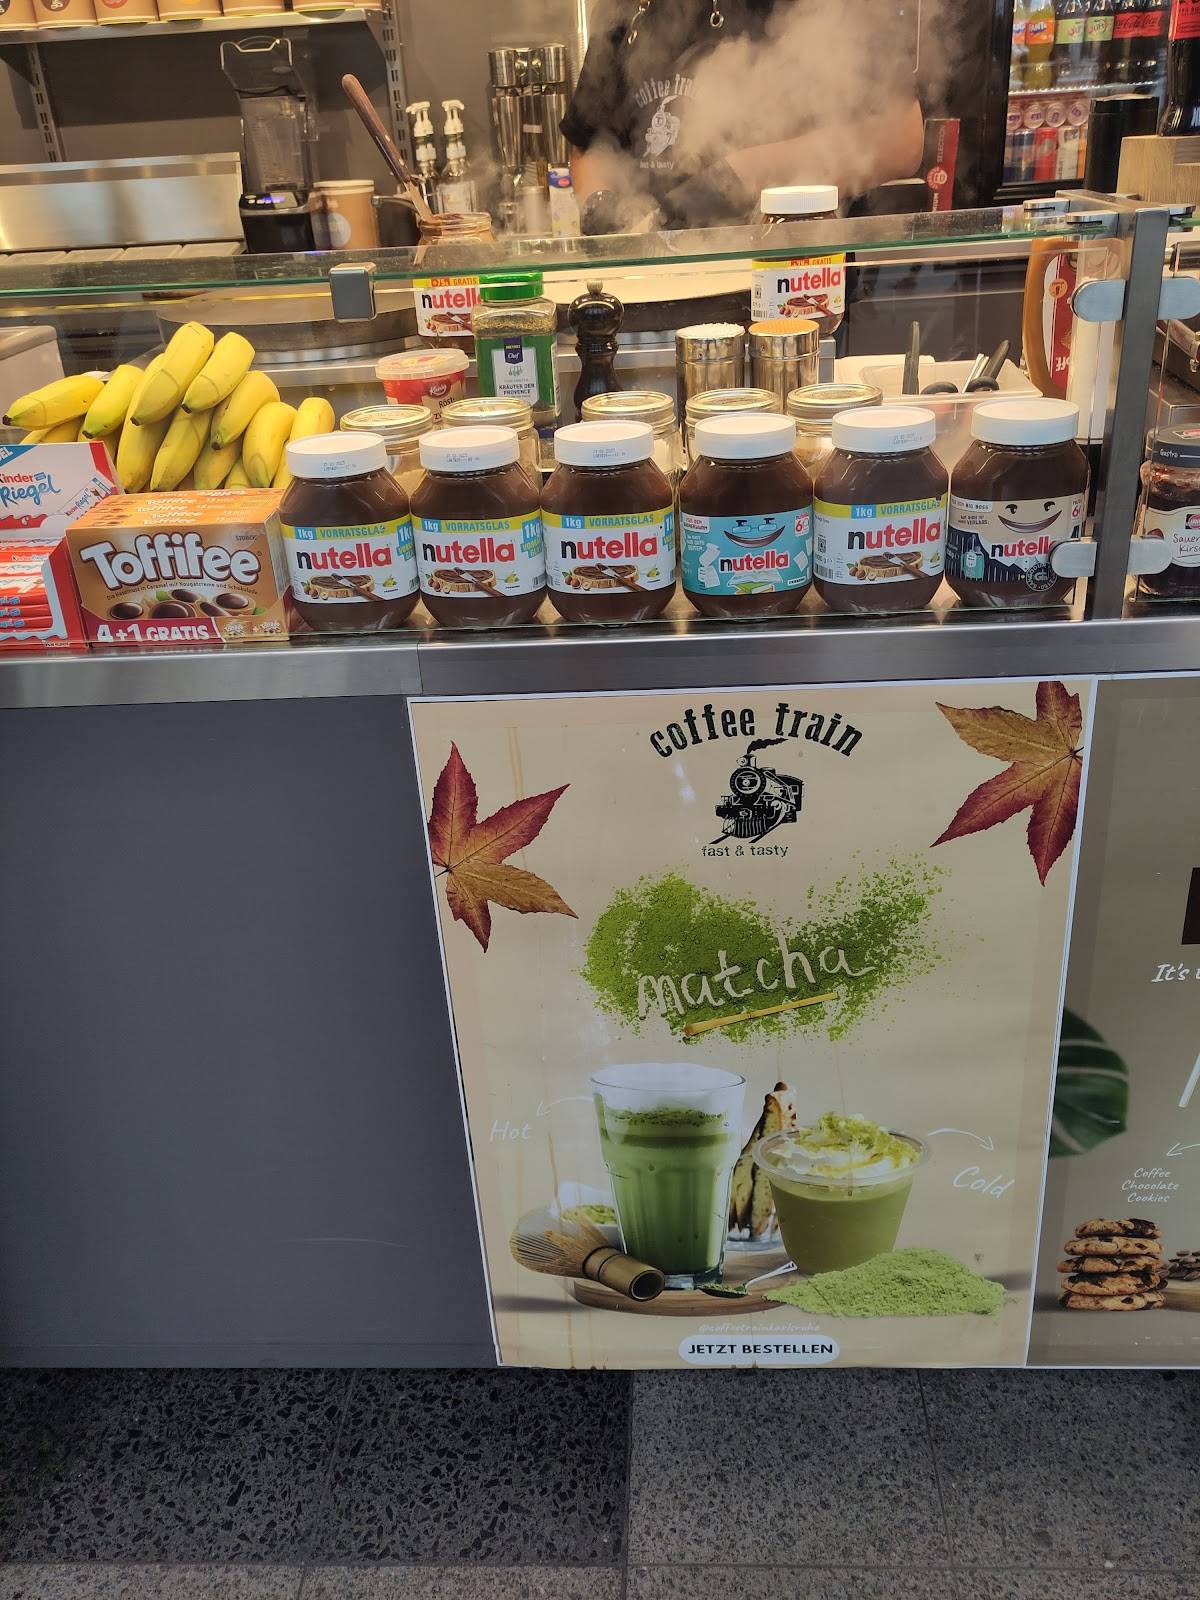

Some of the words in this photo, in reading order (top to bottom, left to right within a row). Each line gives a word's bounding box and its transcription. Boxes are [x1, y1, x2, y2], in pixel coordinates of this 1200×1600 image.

[674, 73, 698, 97] tra
[777, 267, 841, 293] nutella
[0, 474, 61, 507] Riegel
[855, 506, 872, 519] 1kg
[881, 500, 940, 515] VORRATSGLAS
[423, 520, 439, 533] 1kg
[445, 520, 510, 531] VORRATSGLAS
[565, 517, 582, 529] 1kg
[589, 514, 654, 526] VORRATSGLAS
[297, 529, 313, 540] 1kg
[320, 525, 385, 538] VORRATSGLAS
[848, 517, 941, 550] nutella
[423, 538, 515, 563] nutella
[561, 532, 657, 559] nutella
[1180, 544, 1200, 555] Kirs
[80, 532, 261, 590] Toffifee
[296, 543, 392, 570] nutella
[720, 551, 789, 572] nutella
[147, 582, 168, 590] Caramel
[146, 625, 209, 641] GRATIS
[650, 703, 755, 758] coffee
[775, 702, 863, 757] train
[701, 845, 730, 857] fast
[735, 845, 745, 857] &
[750, 844, 789, 858] tasty
[1152, 963, 1190, 982] It's
[489, 1119, 531, 1142] Hot
[953, 1166, 1015, 1198] Cold
[1134, 1167, 1171, 1179] Coffee
[1121, 1180, 1179, 1191] Chocolate
[1127, 1192, 1170, 1203] Cookies
[688, 1344, 737, 1354] JETZT
[742, 1344, 833, 1354] BESTELLEN
